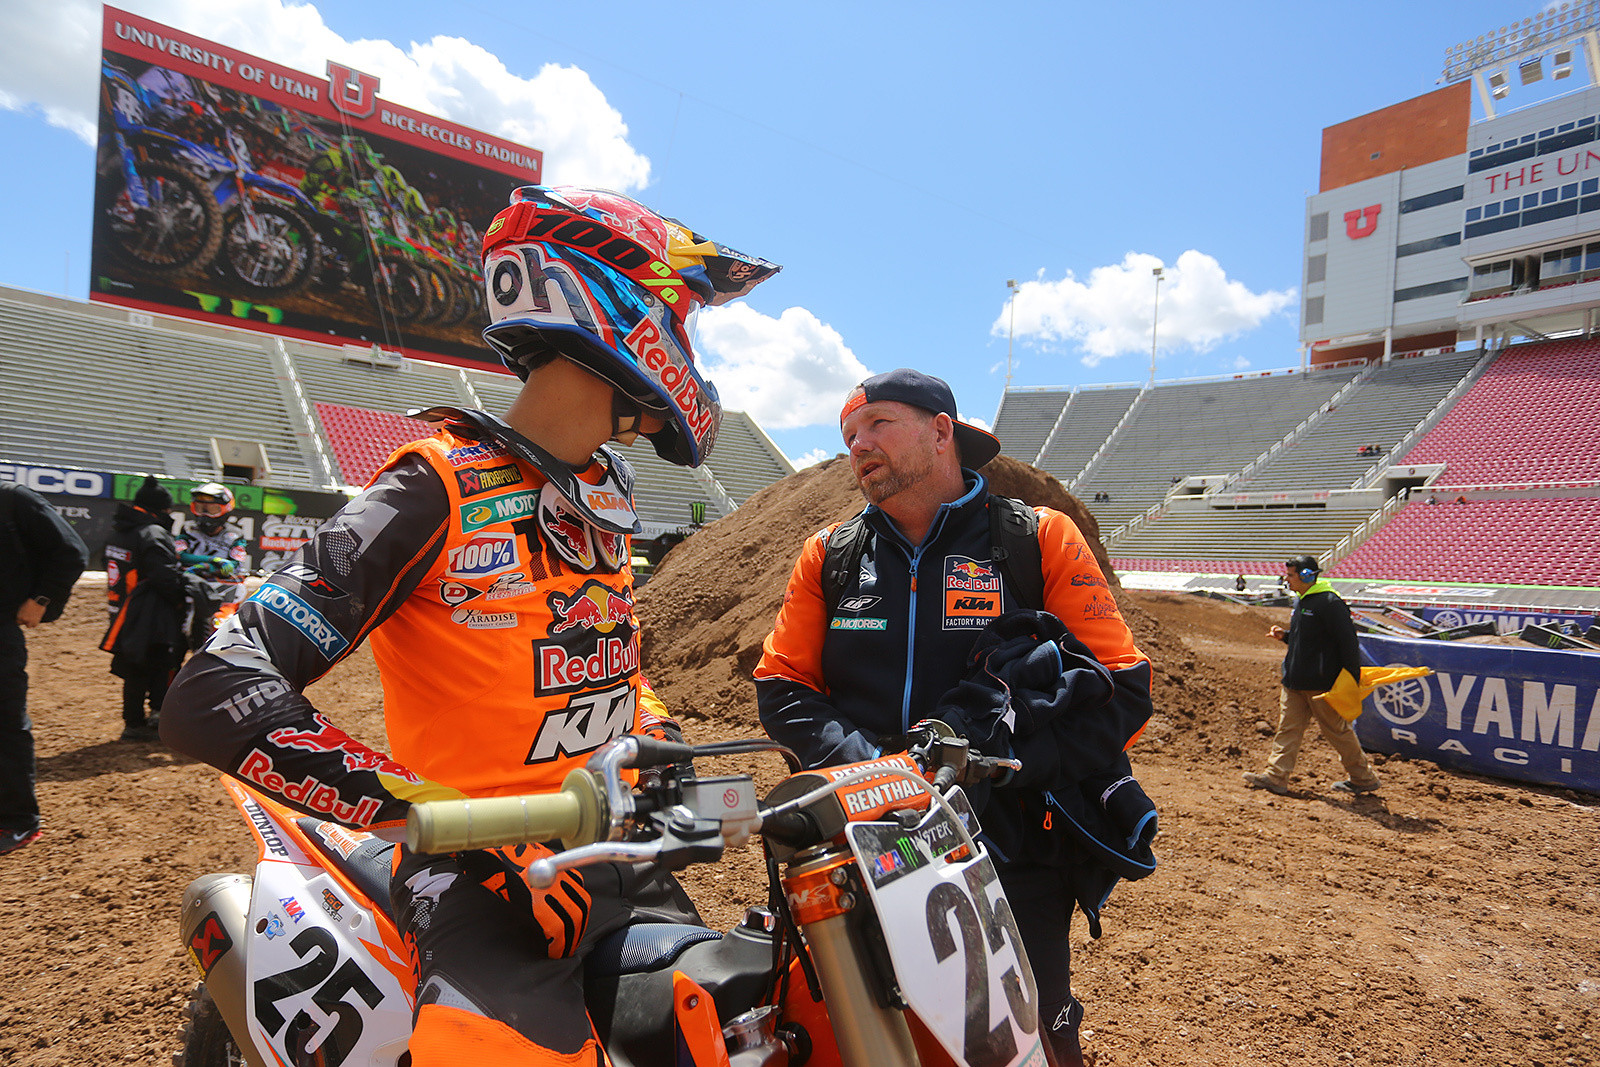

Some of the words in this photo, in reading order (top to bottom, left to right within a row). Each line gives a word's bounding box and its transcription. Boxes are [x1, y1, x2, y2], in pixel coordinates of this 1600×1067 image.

[114, 21, 235, 74] UNIVERSITY
[238, 63, 265, 83] OF
[270, 73, 318, 101] UTAH
[381, 109, 472, 150] RICE-ECCLES
[475, 140, 538, 171] STADIUM
[1485, 162, 1544, 194] THE
[1558, 150, 1600, 175] UN
[1344, 204, 1381, 240] U
[525, 213, 684, 304] 100%
[623, 315, 690, 393] Red
[674, 378, 713, 445] Bull
[495, 494, 540, 517] MOTO
[587, 491, 631, 512] KTM
[454, 540, 510, 571] 100%
[946, 575, 972, 590] Red
[973, 577, 999, 590] Bull
[256, 587, 339, 651] MOTOREX
[946, 618, 974, 626] FACTORY
[976, 618, 992, 626] RAC
[953, 597, 994, 610] KTM
[841, 619, 885, 629] MOTOREX
[540, 637, 606, 690] Red
[607, 630, 639, 678] Bull
[530, 685, 636, 760] KTM
[237, 748, 320, 805] Red
[306, 782, 384, 828] Bull
[845, 779, 925, 815] RENTHAL
[245, 802, 289, 857] DUNLOP
[874, 850, 905, 878] AMA
[279, 896, 306, 924] AMA
[322, 889, 343, 911] 450
[926, 855, 1039, 1067] 25
[254, 926, 386, 1067] 25
